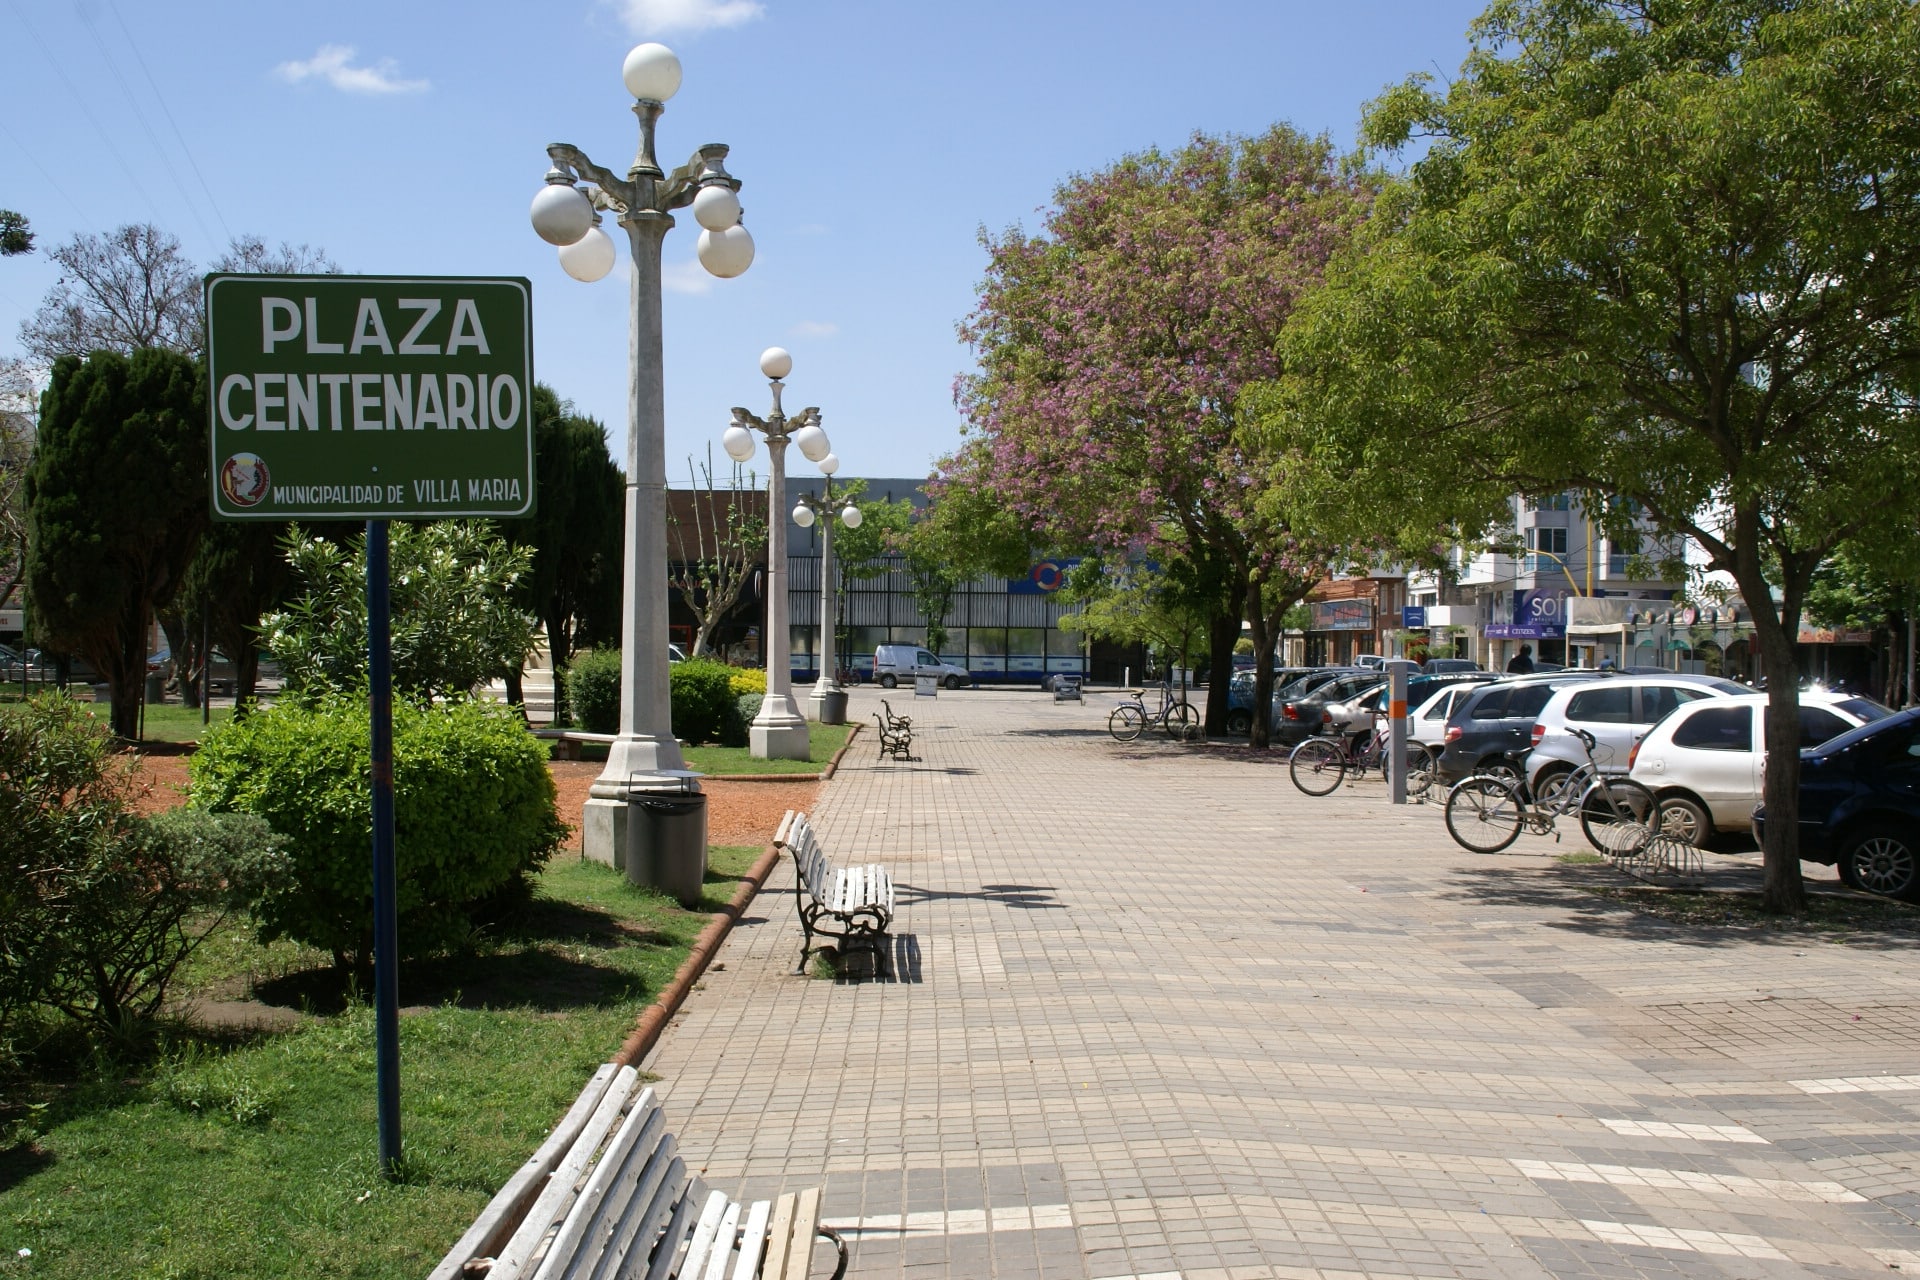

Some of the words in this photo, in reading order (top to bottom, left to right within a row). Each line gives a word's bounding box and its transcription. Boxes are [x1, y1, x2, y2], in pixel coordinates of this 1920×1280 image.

[261, 296, 491, 355] PLAZA
[218, 373, 522, 431] CENTENARIO
[273, 485, 383, 505] MUNICIPALIDAD
[387, 484, 404, 504] DE
[413, 479, 461, 503] VILLA
[468, 478, 522, 502] MARIA
